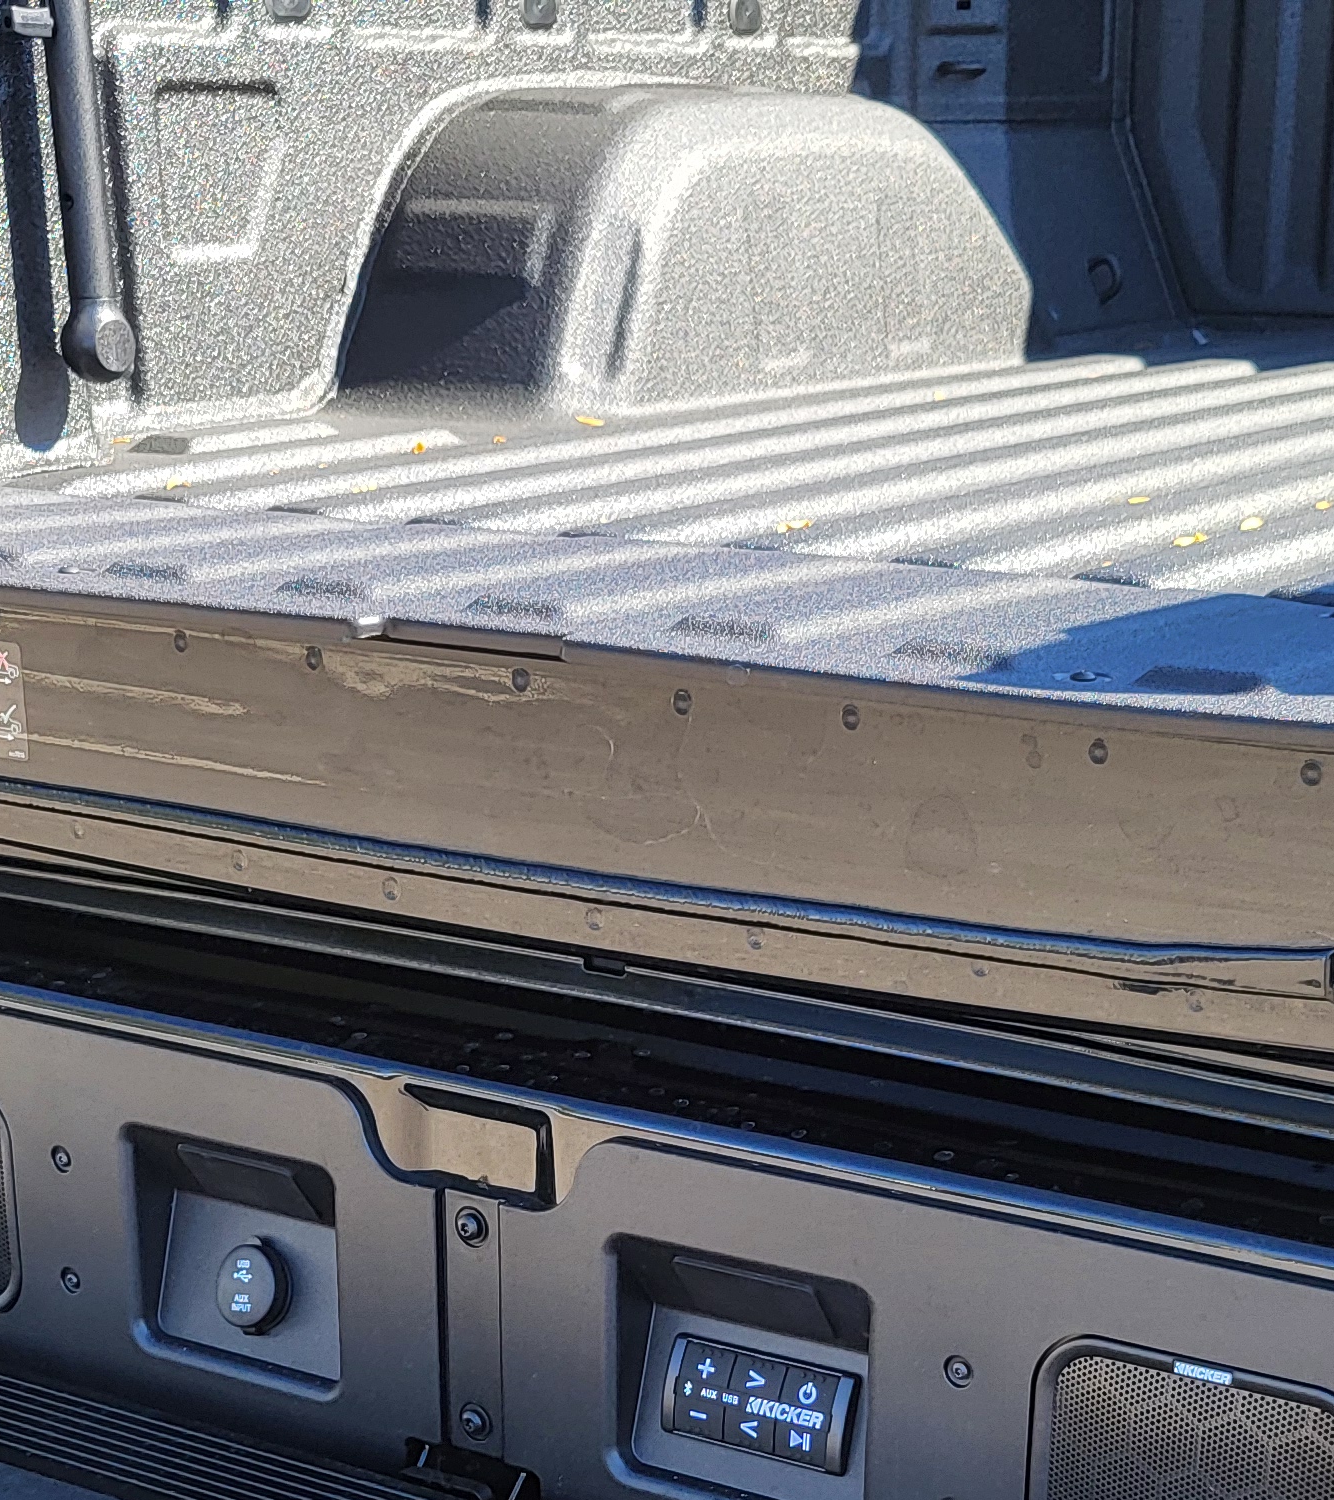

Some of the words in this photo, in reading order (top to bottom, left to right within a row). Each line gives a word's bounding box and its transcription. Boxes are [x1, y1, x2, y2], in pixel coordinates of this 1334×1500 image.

[234, 1293, 250, 1303] AUX
[231, 1303, 252, 1313] INPUT
[1184, 1365, 1232, 1385] KICKER
[700, 1387, 718, 1400] AUX
[722, 1392, 739, 1405] USB
[759, 1400, 825, 1430] KICKER
